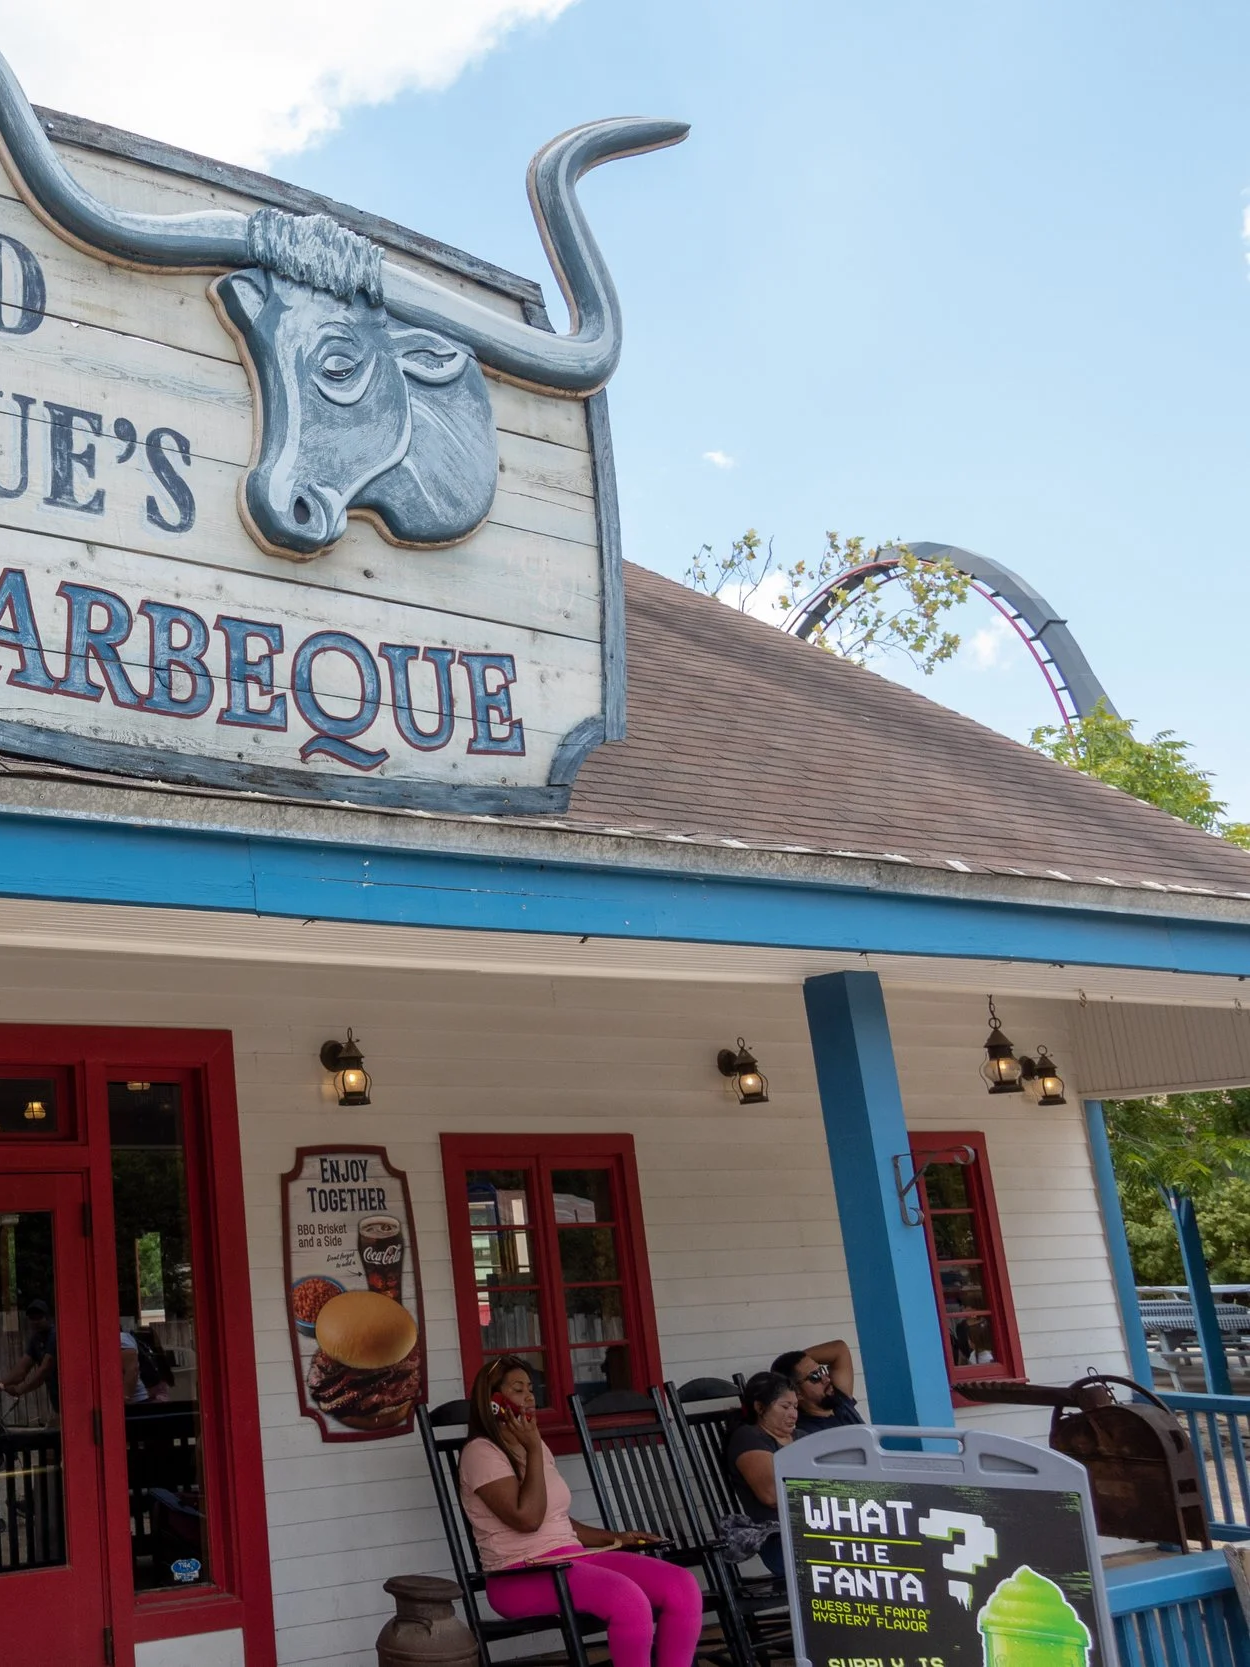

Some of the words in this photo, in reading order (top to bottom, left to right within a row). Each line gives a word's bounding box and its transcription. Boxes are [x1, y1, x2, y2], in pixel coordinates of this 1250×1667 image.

[319, 1158, 368, 1183] ENJOY
[307, 1187, 387, 1212] TOGETHER
[297, 1224, 315, 1236] BBQ
[318, 1223, 347, 1235] Brisket
[298, 1237, 314, 1248] and
[317, 1239, 322, 1247] a
[324, 1236, 343, 1247] Side
[803, 1495, 912, 1535] WHAT
[830, 1541, 890, 1563] THE
[811, 1565, 924, 1602] FANTA
[811, 1599, 851, 1612] GUESS
[855, 1603, 880, 1615] THE
[813, 1611, 870, 1626] MYSTERY
[876, 1618, 928, 1632] FLAVOR
